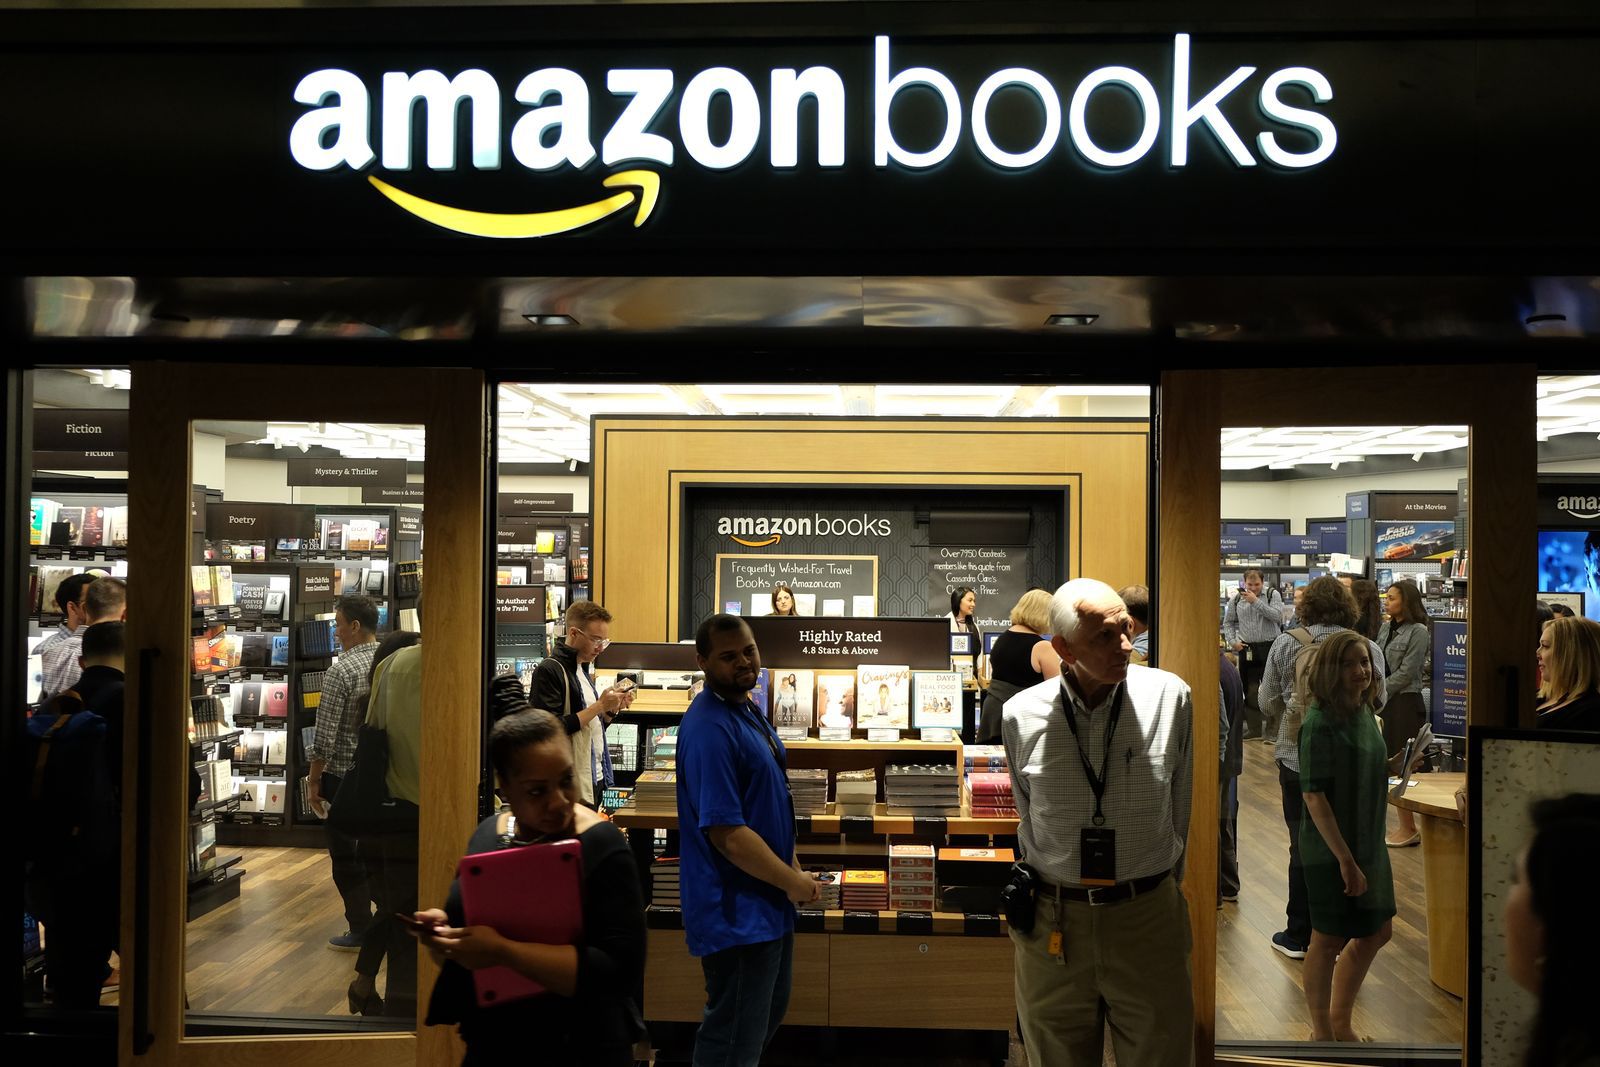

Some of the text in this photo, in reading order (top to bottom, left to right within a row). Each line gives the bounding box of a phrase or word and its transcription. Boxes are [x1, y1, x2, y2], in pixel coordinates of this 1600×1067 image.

[290, 33, 1338, 170] amazon books
[65, 424, 102, 434] Fiction
[315, 468, 342, 477] Mystery
[351, 468, 378, 476] Thriller
[229, 515, 256, 525] Poetry
[717, 513, 892, 536] amazon books
[940, 548, 960, 558] Over
[978, 548, 1006, 558] Goodreads
[731, 561, 853, 577] Frequently Wished-For Travel
[996, 561, 1011, 571] from
[736, 577, 771, 588] Books
[790, 577, 841, 588] Amazon.com
[946, 572, 976, 583] Cassandra
[799, 630, 883, 645] Highly Rated
[818, 647, 840, 655] Stars
[842, 647, 849, 655] &
[851, 647, 879, 655] Above
